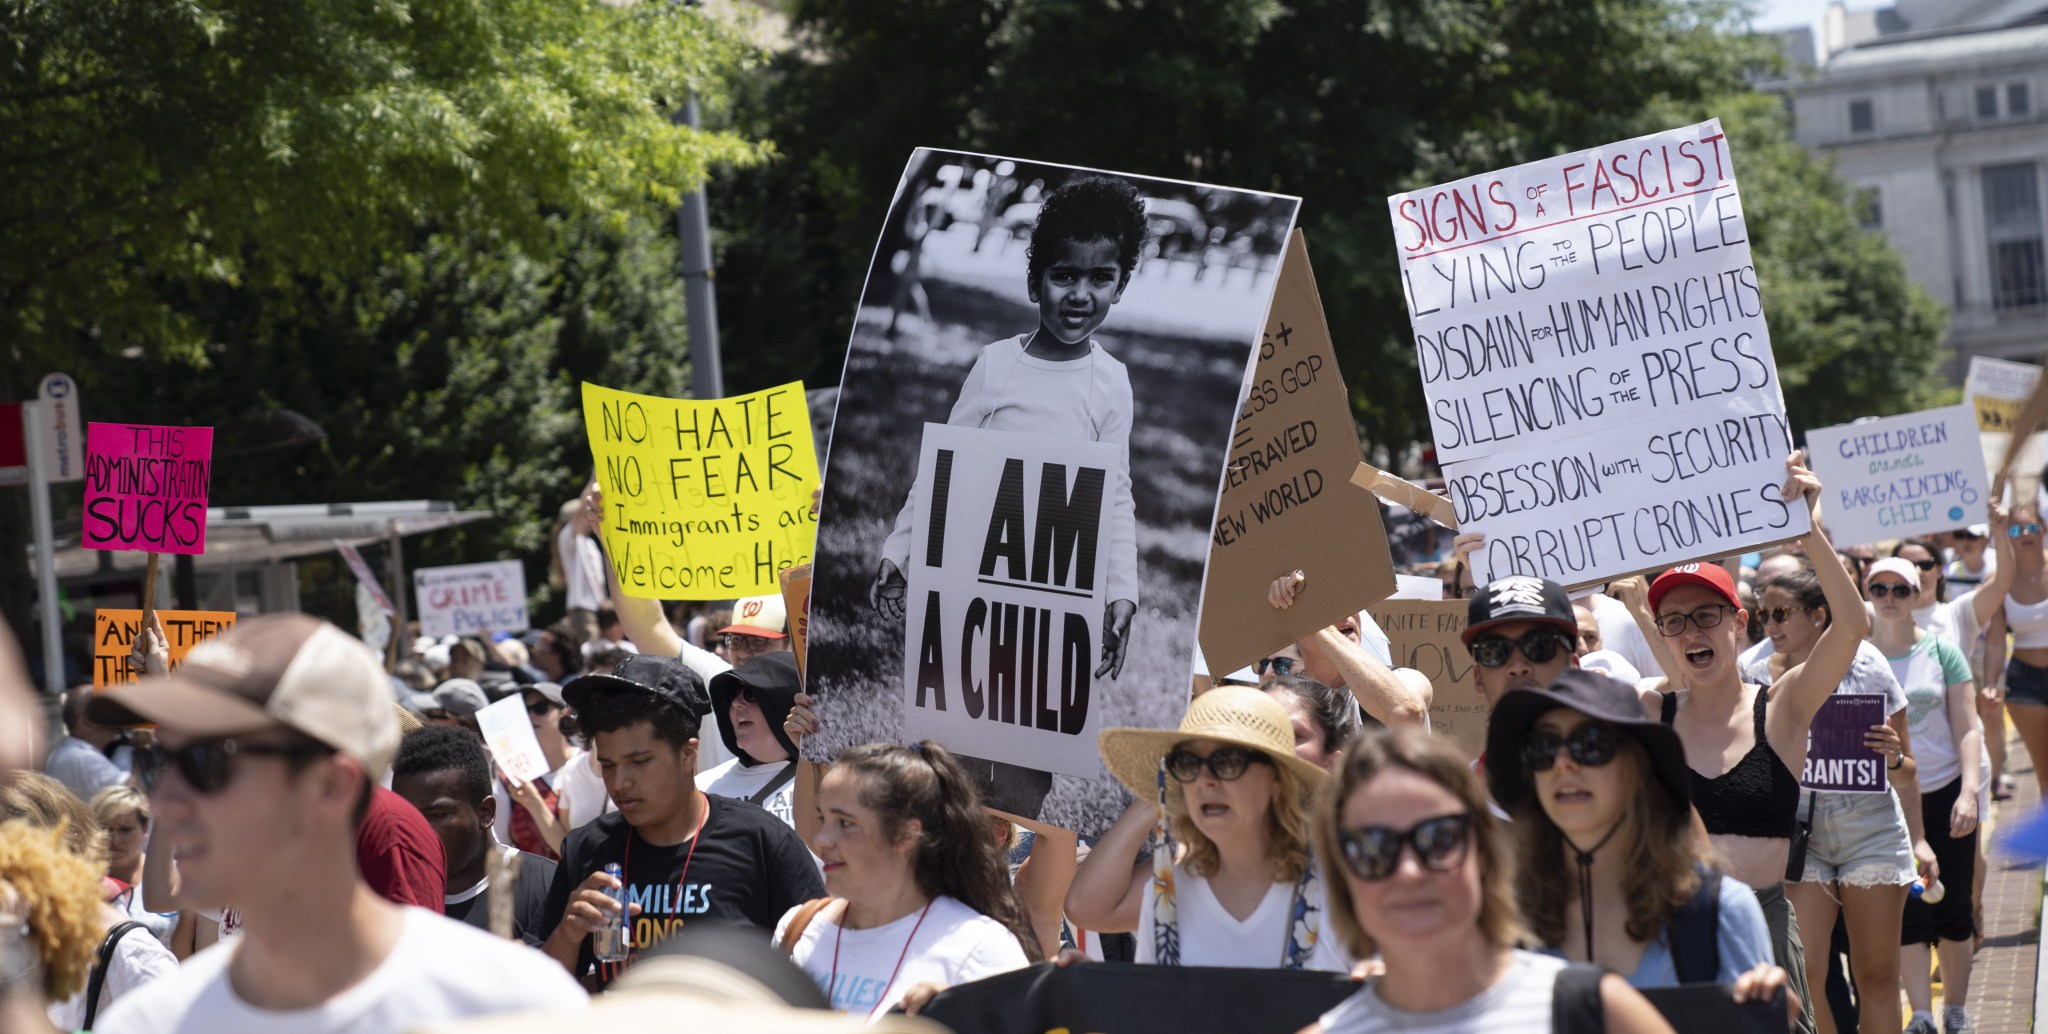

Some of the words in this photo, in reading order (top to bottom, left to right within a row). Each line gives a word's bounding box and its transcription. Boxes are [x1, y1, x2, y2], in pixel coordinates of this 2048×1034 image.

[1400, 180, 1518, 252] SIGNS
[1526, 183, 1548, 200] OF
[1563, 133, 1725, 217] FASCIST
[1535, 203, 1547, 218] A
[1404, 240, 1547, 317] LYING
[1552, 238, 1572, 252] TO
[1588, 193, 1746, 276] PEOPLE
[1550, 251, 1578, 269] THE
[1417, 311, 1534, 384] DISDAIN
[1531, 326, 1553, 341] FOR
[1548, 289, 1650, 358] HUMAN
[1652, 265, 1763, 336] RIGHTS
[1281, 355, 1323, 394] GOP
[1435, 367, 1604, 450] SILENCING
[1609, 369, 1631, 386] OF
[1643, 332, 1769, 408] PRESS
[1609, 387, 1641, 404] THE
[126, 426, 185, 458] THIS
[602, 400, 648, 443] NO
[675, 390, 792, 451] HATE
[1839, 421, 1948, 459] CHILDREN
[84, 451, 209, 499] ADMINISTRATION
[607, 455, 642, 497] NO
[670, 444, 803, 500] FEAR
[1449, 452, 1602, 525] OBSESSION
[1602, 458, 1642, 477] WITH
[1648, 412, 1792, 484] SECURITY
[1840, 470, 1968, 510] BARGAINING
[926, 448, 954, 568] I
[978, 458, 1106, 591] AM
[1251, 469, 1324, 525] WORLD
[1878, 500, 1932, 527] CHIP
[88, 497, 203, 548] SUCKS
[616, 503, 760, 547] Immigrants
[1487, 511, 1626, 582] ORRUPT
[1633, 483, 1790, 556] CRONIES
[606, 537, 735, 590] Welcome
[429, 579, 511, 611] CRIME
[452, 607, 523, 632] POLICY
[1438, 612, 1469, 632] FAM
[916, 590, 947, 711] A
[961, 597, 1091, 736] CHILD
